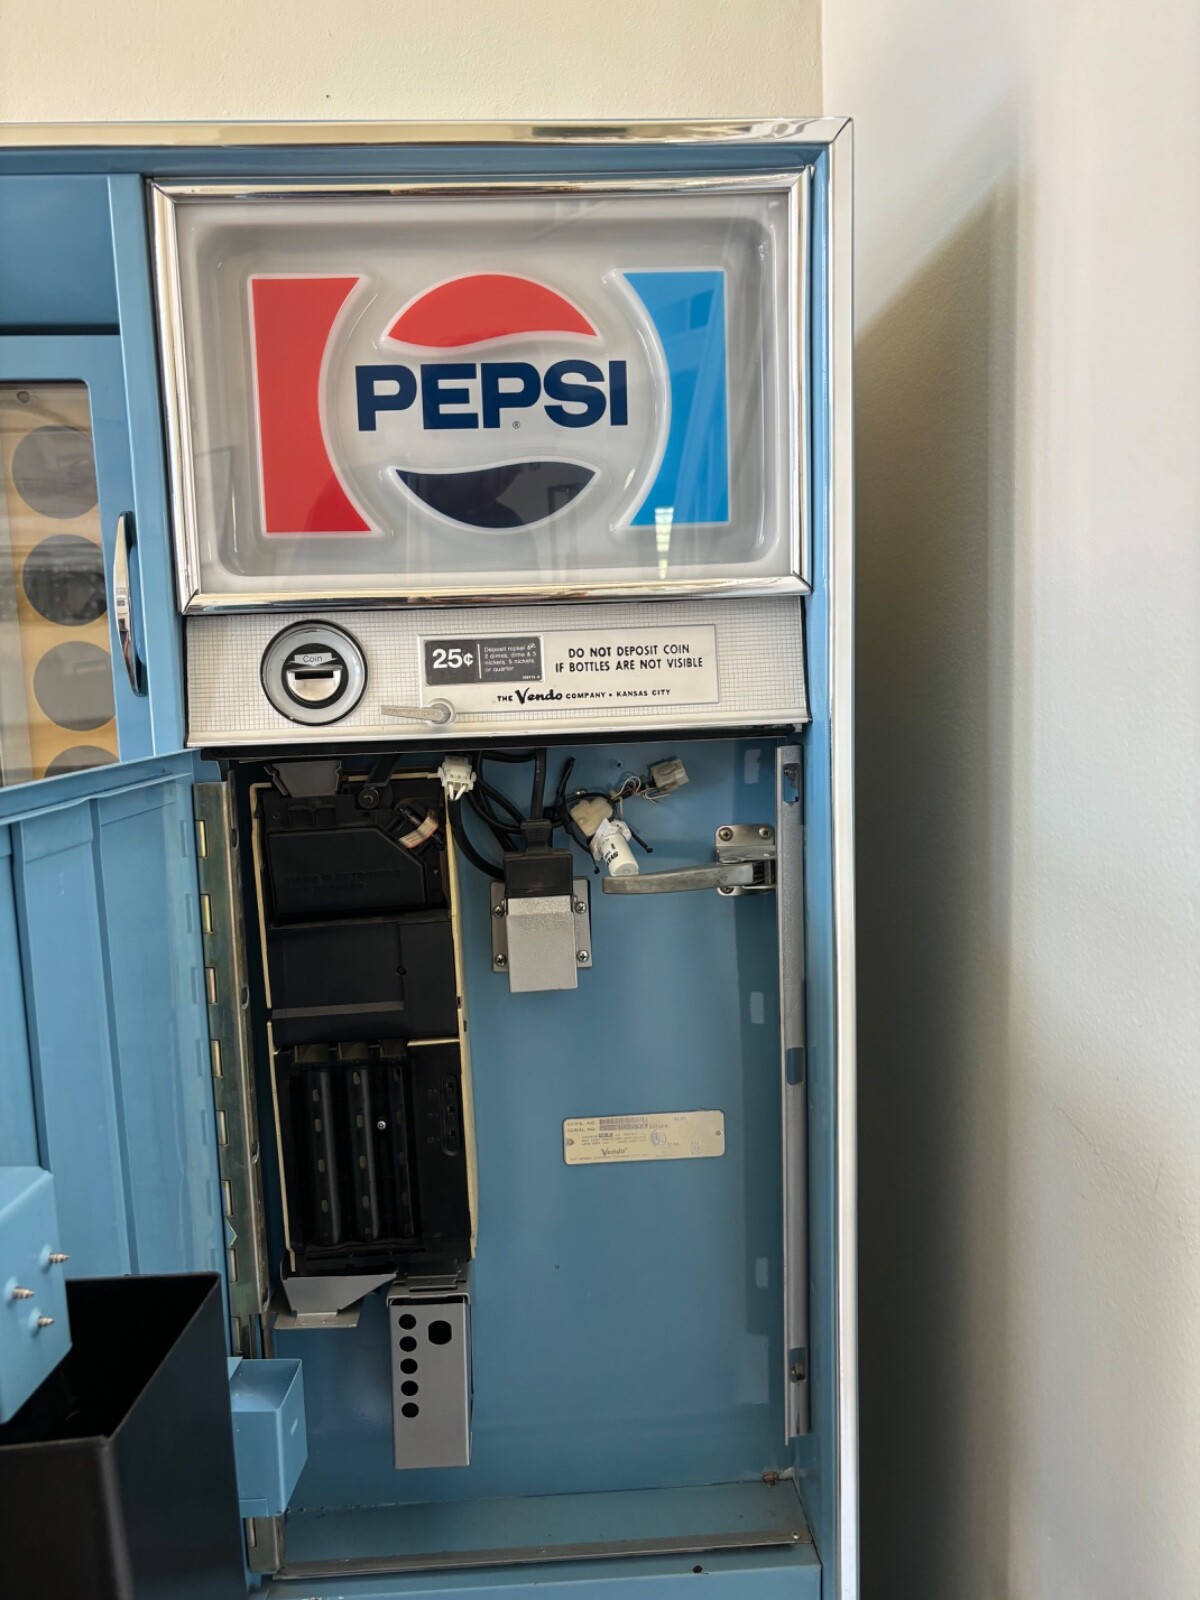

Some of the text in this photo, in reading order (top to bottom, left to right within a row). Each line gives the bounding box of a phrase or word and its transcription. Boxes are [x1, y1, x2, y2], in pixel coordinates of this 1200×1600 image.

[355, 359, 628, 431] PEPSI
[302, 654, 323, 663] Coin
[432, 648, 474, 669] 25¢
[568, 644, 690, 658] DO NOT DEPOSIT COIN
[555, 657, 703, 672] IF BOTTLES ARE NOT VISIBLE
[515, 687, 563, 704] Vendo
